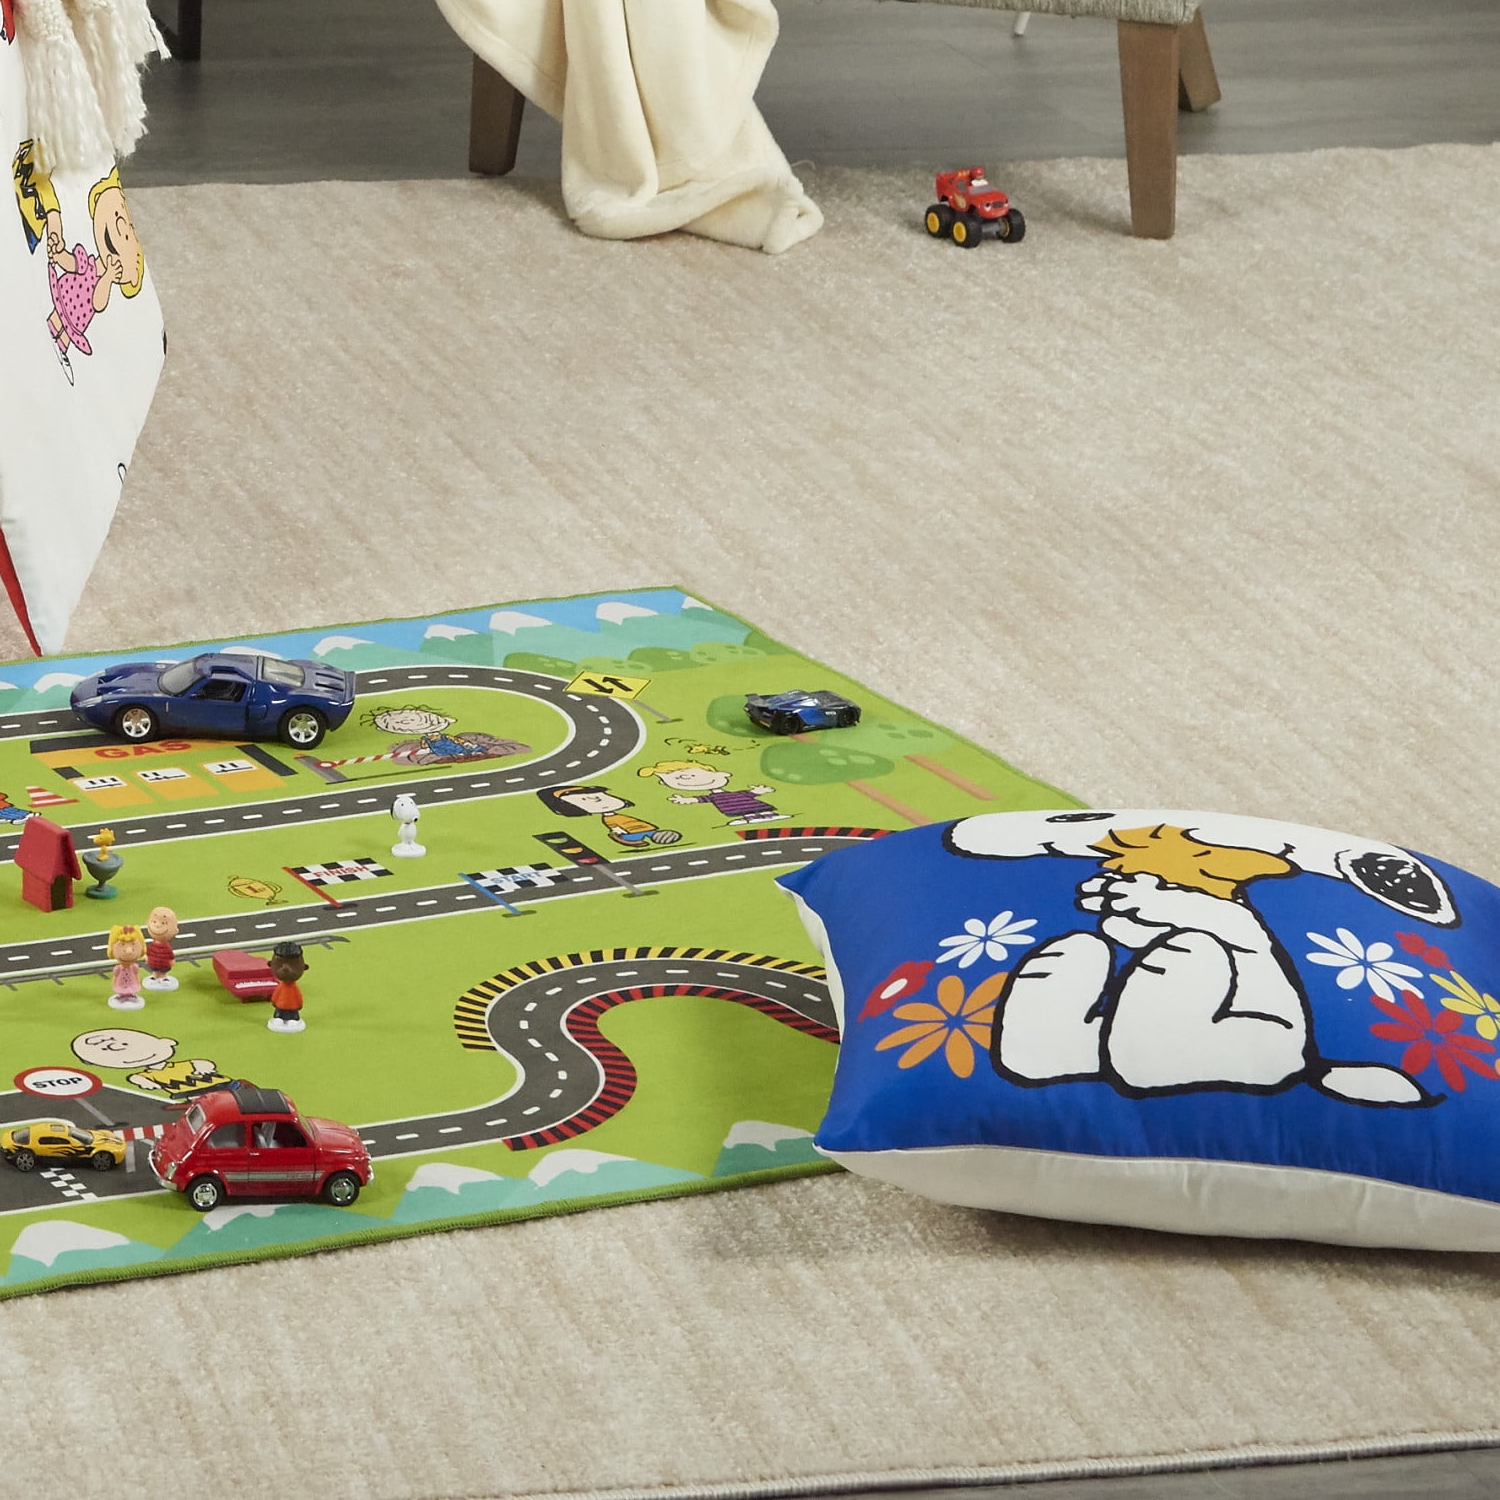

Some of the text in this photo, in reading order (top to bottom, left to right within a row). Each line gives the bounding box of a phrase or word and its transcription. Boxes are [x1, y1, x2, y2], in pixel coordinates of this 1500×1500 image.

[94, 739, 192, 759] GAS
[313, 865, 370, 878] FINISH
[490, 872, 541, 884] START
[32, 1077, 82, 1089] STOP
